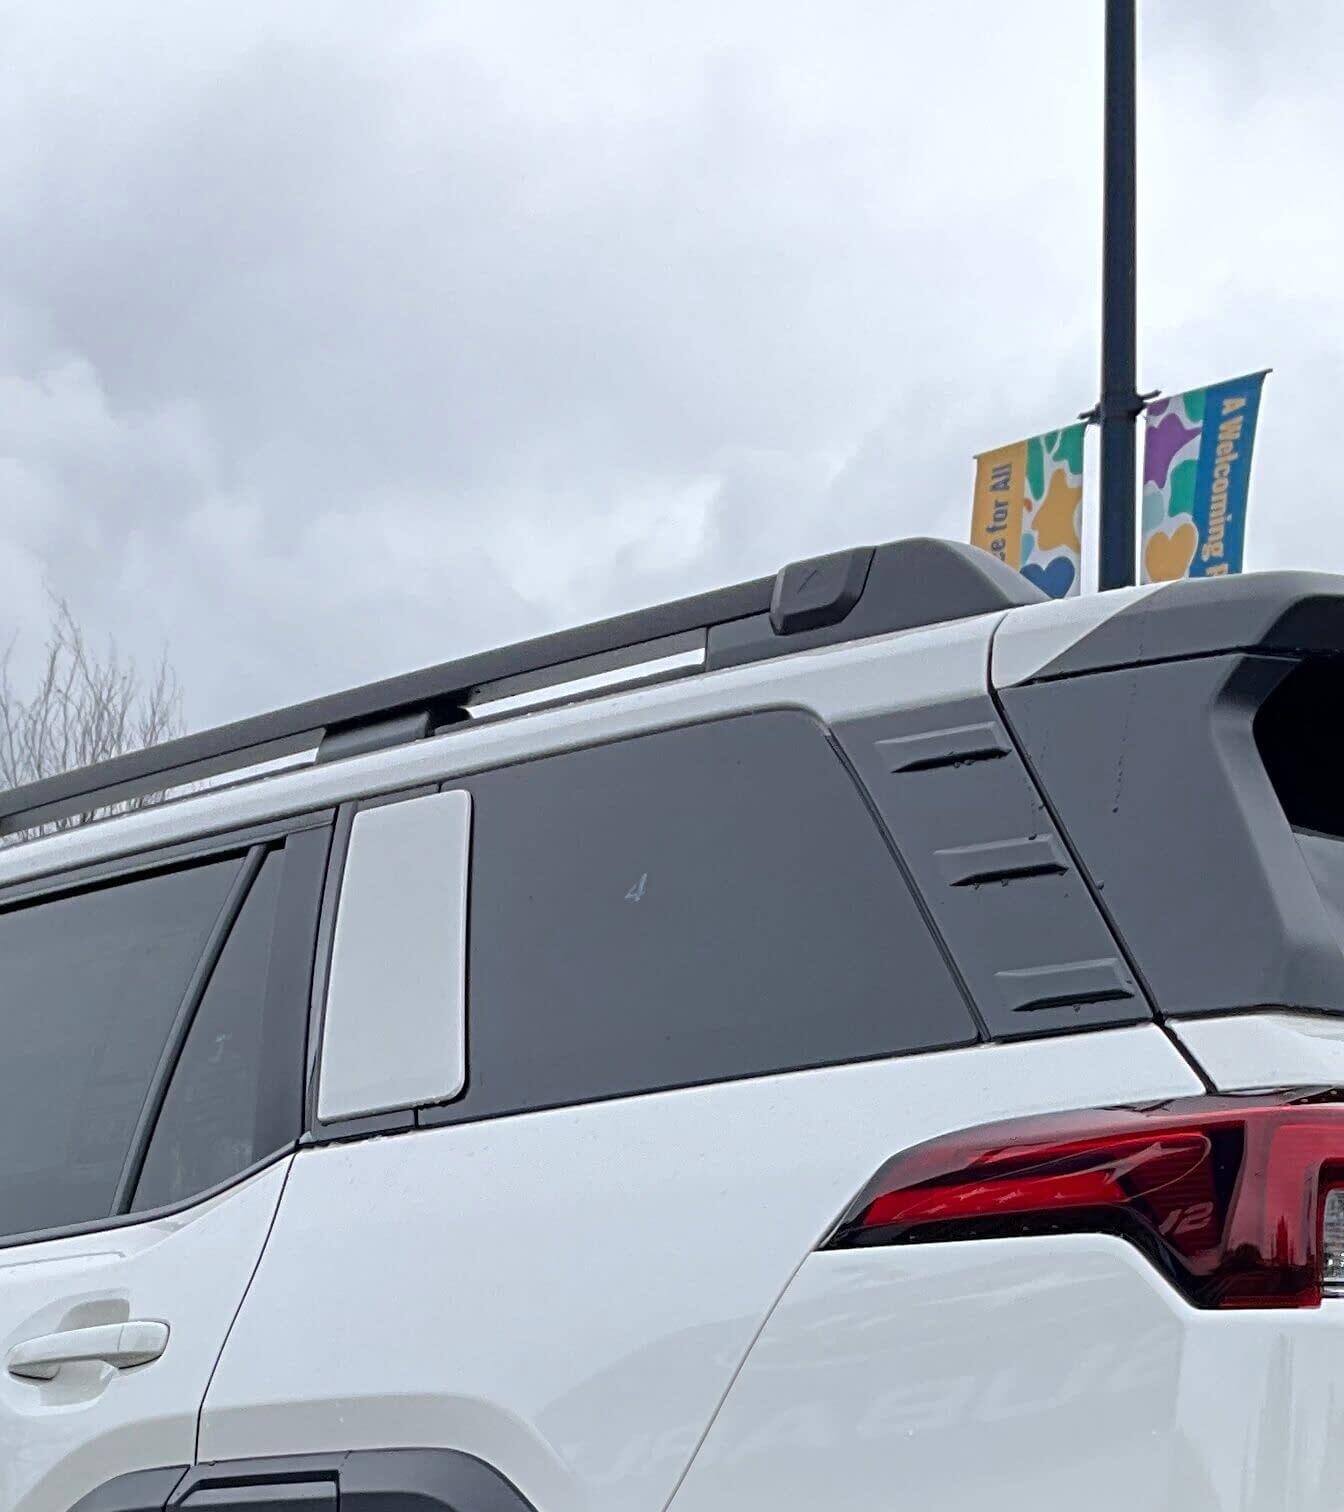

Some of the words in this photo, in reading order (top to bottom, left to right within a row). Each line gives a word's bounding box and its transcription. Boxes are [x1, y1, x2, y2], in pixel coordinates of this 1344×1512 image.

[990, 463, 1012, 492] All
[1201, 416, 1244, 562] Welcoming
[986, 499, 1009, 533] for
